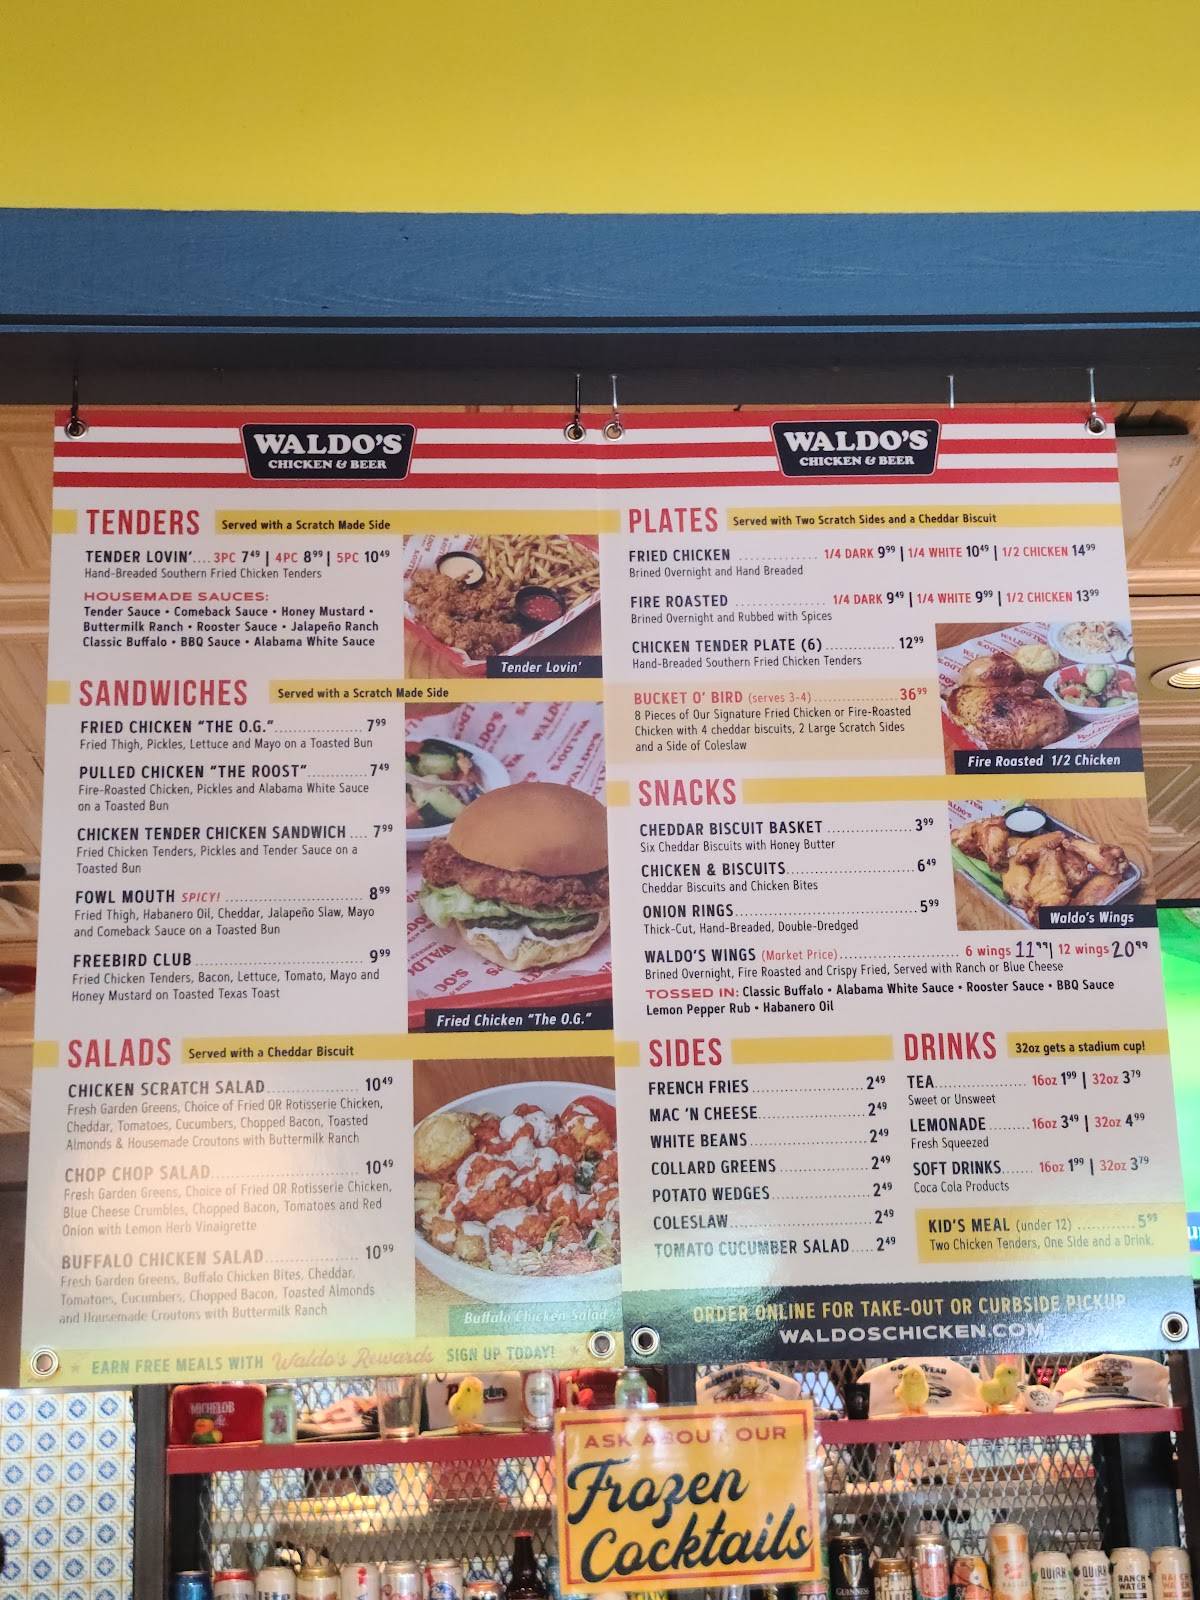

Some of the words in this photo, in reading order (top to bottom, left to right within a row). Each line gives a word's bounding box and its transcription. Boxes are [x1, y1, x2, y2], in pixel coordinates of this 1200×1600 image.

[253, 434, 402, 454] WALDO'S
[783, 429, 928, 452] WALDO'S
[268, 459, 333, 469] CHICKEN
[336, 460, 347, 469] &
[350, 460, 387, 469] BEER
[799, 456, 862, 466] CHICKEN
[864, 456, 876, 465] &
[878, 455, 915, 465] BEER
[86, 509, 200, 535] TENDERS
[222, 519, 257, 530] Served
[260, 519, 283, 530] with
[286, 522, 292, 530] a
[296, 519, 335, 530] Scratch
[338, 519, 365, 530] Made
[369, 519, 391, 530] Side
[629, 506, 718, 534] PLATES
[733, 515, 767, 526] Served
[770, 515, 792, 526] with
[795, 515, 815, 525] Two
[818, 514, 856, 525] Scratch
[859, 514, 886, 524] Sides
[888, 513, 907, 524] and
[909, 516, 915, 524] a
[918, 513, 959, 524] Cheddar
[963, 513, 996, 523] Biscuit
[86, 550, 141, 564] TENDER
[147, 550, 192, 563] LOVIN'
[214, 552, 235, 563] 3PC
[275, 552, 297, 563] 4PC
[337, 552, 358, 563] 5PC
[629, 550, 668, 562] FRIED
[673, 548, 730, 562] CHICKEN
[825, 548, 841, 559] 1/4
[845, 548, 874, 559] DARK
[908, 547, 925, 558] 1/4
[928, 547, 962, 558] WHITE
[1003, 546, 1019, 557] 1/2
[1023, 546, 1068, 557] CHICKEN
[85, 567, 157, 579] Hand-Breaded
[161, 567, 207, 579] Southern
[210, 567, 237, 579] Fried
[240, 566, 279, 579] Chicken
[283, 567, 322, 579] Tenders
[84, 592, 192, 602] HOUSEMADE
[198, 592, 269, 602] SAUCES:
[84, 606, 123, 617] Tender
[127, 606, 161, 617] Sauce
[174, 605, 231, 617] Comeback
[235, 606, 268, 617] Sauce
[281, 605, 316, 620] Honey
[319, 605, 366, 617] Mustard
[501, 661, 542, 673] Tender
[546, 661, 582, 673] Lovin'
[79, 679, 247, 707] SANDWICHES
[634, 691, 687, 705] BUCKET
[692, 691, 705, 704] O'
[711, 691, 743, 704] BIRD
[748, 693, 785, 705] (serves
[789, 691, 811, 704] 3-4)
[81, 720, 123, 734] FRIED
[129, 720, 192, 734] CHICKEN
[968, 755, 991, 767] Fire
[995, 754, 1044, 767] Roasted
[1052, 754, 1071, 766] 1/2
[1075, 753, 1120, 766] Chicken
[638, 778, 736, 807] SNACKS
[640, 822, 704, 837] CHEDDAR
[709, 821, 763, 835] BISCUIT
[769, 820, 822, 834] BASKET
[76, 890, 115, 904] FOWL
[122, 889, 175, 904] MOUTH
[181, 891, 220, 903] SPICY!
[1050, 911, 1095, 924] Waldo's
[1099, 911, 1134, 927] Wings
[644, 949, 706, 963] WALDO'S
[711, 948, 756, 962] WINGS
[761, 949, 803, 963] (Market
[807, 949, 839, 961] Price)
[977, 944, 1011, 960] wings
[1075, 942, 1109, 958] wings
[437, 1014, 470, 1027] Fried
[474, 1013, 523, 1027] Chicken
[68, 1036, 171, 1069] SALADS
[649, 1037, 722, 1068] SIDES
[904, 1031, 997, 1061] DRINKS
[1015, 1042, 1040, 1054] 32oz
[1043, 1042, 1066, 1056] gets
[1069, 1044, 1075, 1052] a
[1078, 1040, 1120, 1052] stadium
[1123, 1040, 1145, 1055] cup!
[649, 1080, 704, 1095] FRENCH
[709, 1079, 749, 1094] FRIES
[907, 1075, 934, 1089] TEA
[1032, 1074, 1057, 1086] 16oz
[1092, 1072, 1118, 1085] 32oz
[68, 1082, 134, 1098] CHICKEN
[141, 1080, 209, 1096] SCRATCH
[215, 1080, 265, 1094] SALAD
[650, 1108, 680, 1122] MAC
[685, 1107, 699, 1121] 'N
[704, 1105, 757, 1121] CHEESE
[910, 1117, 986, 1132] LEMONADE
[928, 1218, 965, 1233] KID'S
[971, 1217, 1010, 1232] MEAL
[694, 1305, 748, 1323] ORDER
[754, 1301, 816, 1320] ONLINE
[822, 1301, 854, 1319] FOR
[860, 1298, 944, 1318] TAKE-OUT
[950, 1297, 972, 1315] OR
[979, 1294, 1060, 1315] CURBSIDE
[1066, 1294, 1126, 1311] PICKUP
[779, 1322, 1045, 1344] WALDOSCHICKEN.COM
[92, 1359, 130, 1375] EARN
[135, 1358, 170, 1373] FREE
[176, 1356, 223, 1372] MEALS
[228, 1355, 263, 1371] WITH
[271, 1348, 346, 1371] Waldo's
[352, 1346, 433, 1369] Rewards
[447, 1347, 478, 1363] SIGN
[483, 1346, 501, 1361] UP
[506, 1344, 555, 1363] TODAY!
[583, 1434, 632, 1449] ASK
[735, 1426, 787, 1442] OUR
[567, 1457, 749, 1529] Frozen
[580, 1502, 813, 1583] Cocktails
